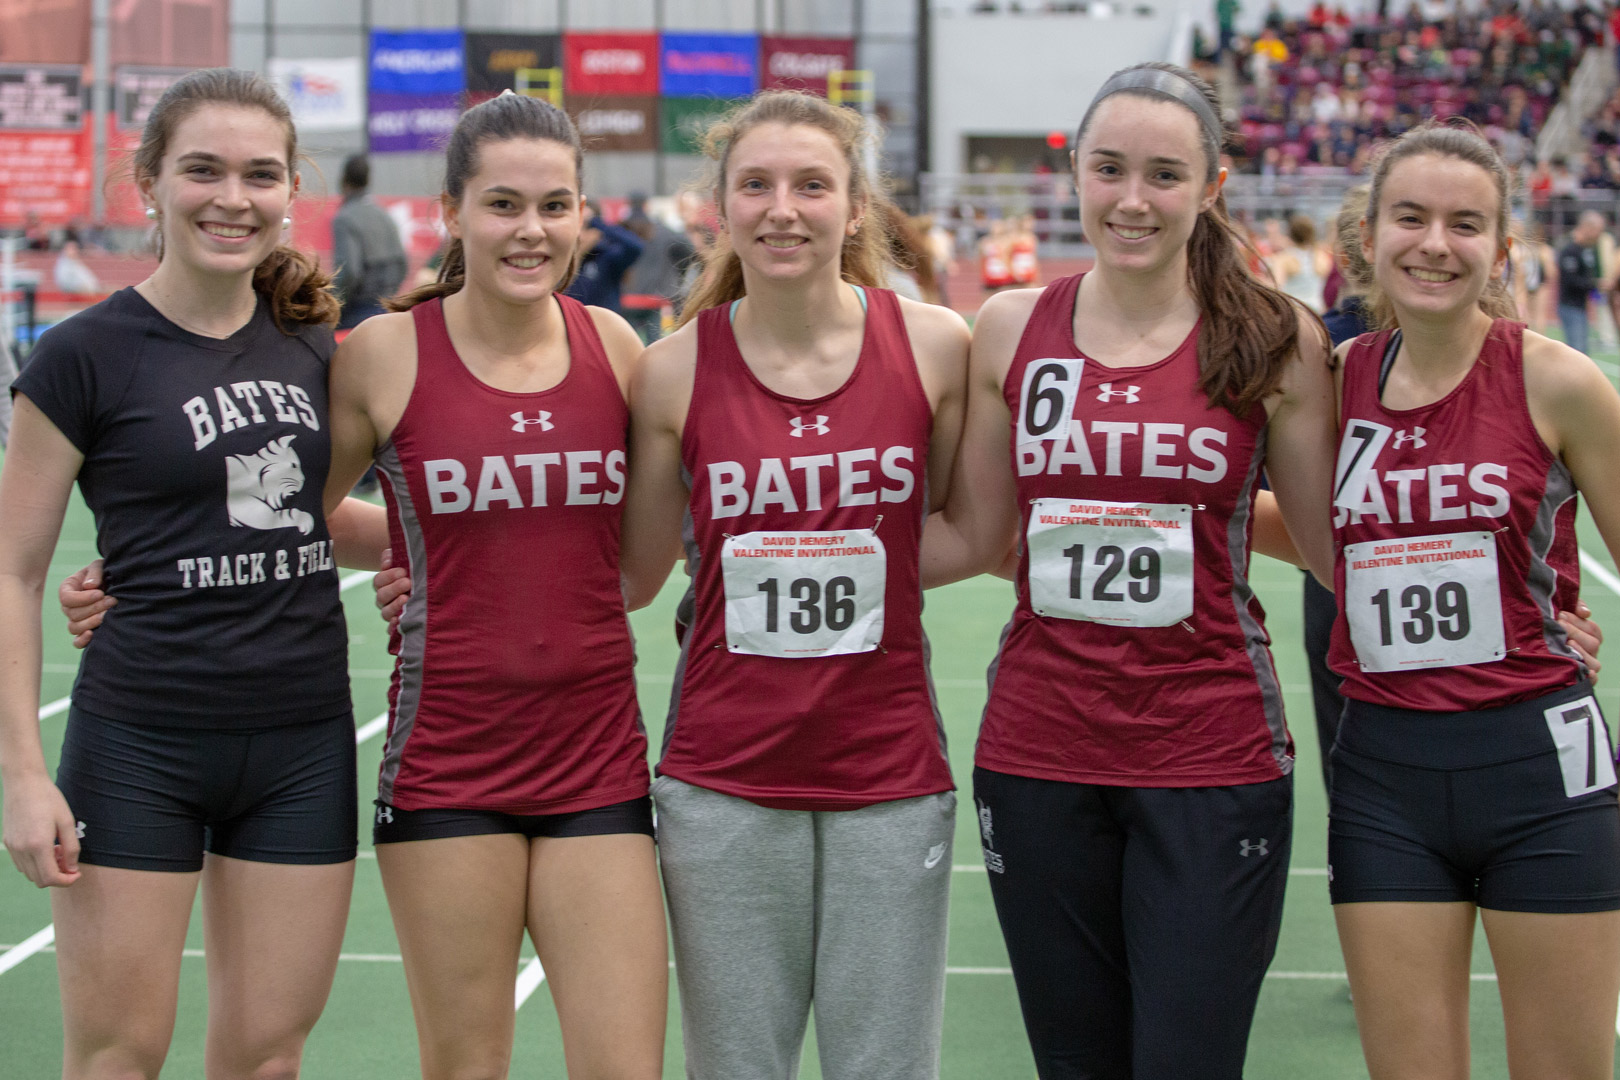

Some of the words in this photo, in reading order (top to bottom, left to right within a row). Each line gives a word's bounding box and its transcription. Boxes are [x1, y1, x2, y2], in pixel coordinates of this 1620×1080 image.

[182, 380, 320, 451] BATES
[1025, 363, 1068, 436] 6
[423, 450, 625, 514] BATES
[707, 445, 915, 519] BATES
[1336, 425, 1378, 500] 7
[1039, 515, 1100, 526] VALENTINE
[1103, 518, 1181, 529] INVITATIONAL
[1069, 504, 1103, 514] DAVID
[1105, 506, 1152, 516] HEMERY
[1333, 462, 1510, 529] ATES
[177, 552, 266, 588] TRACK
[274, 549, 291, 580] &
[733, 549, 795, 558] VALENTINE
[797, 546, 876, 558] INVITATIONAL
[762, 537, 796, 546] DAVID
[799, 536, 846, 545] HEMERY
[1352, 556, 1403, 570] VALENTINE
[1406, 549, 1487, 564] INVITATIONAL
[1374, 544, 1404, 555] DAVID
[1407, 540, 1453, 551] HEMERY
[1063, 543, 1161, 603] 129
[757, 575, 856, 634] 136
[1371, 581, 1471, 646] 139
[1561, 704, 1596, 788] 7
